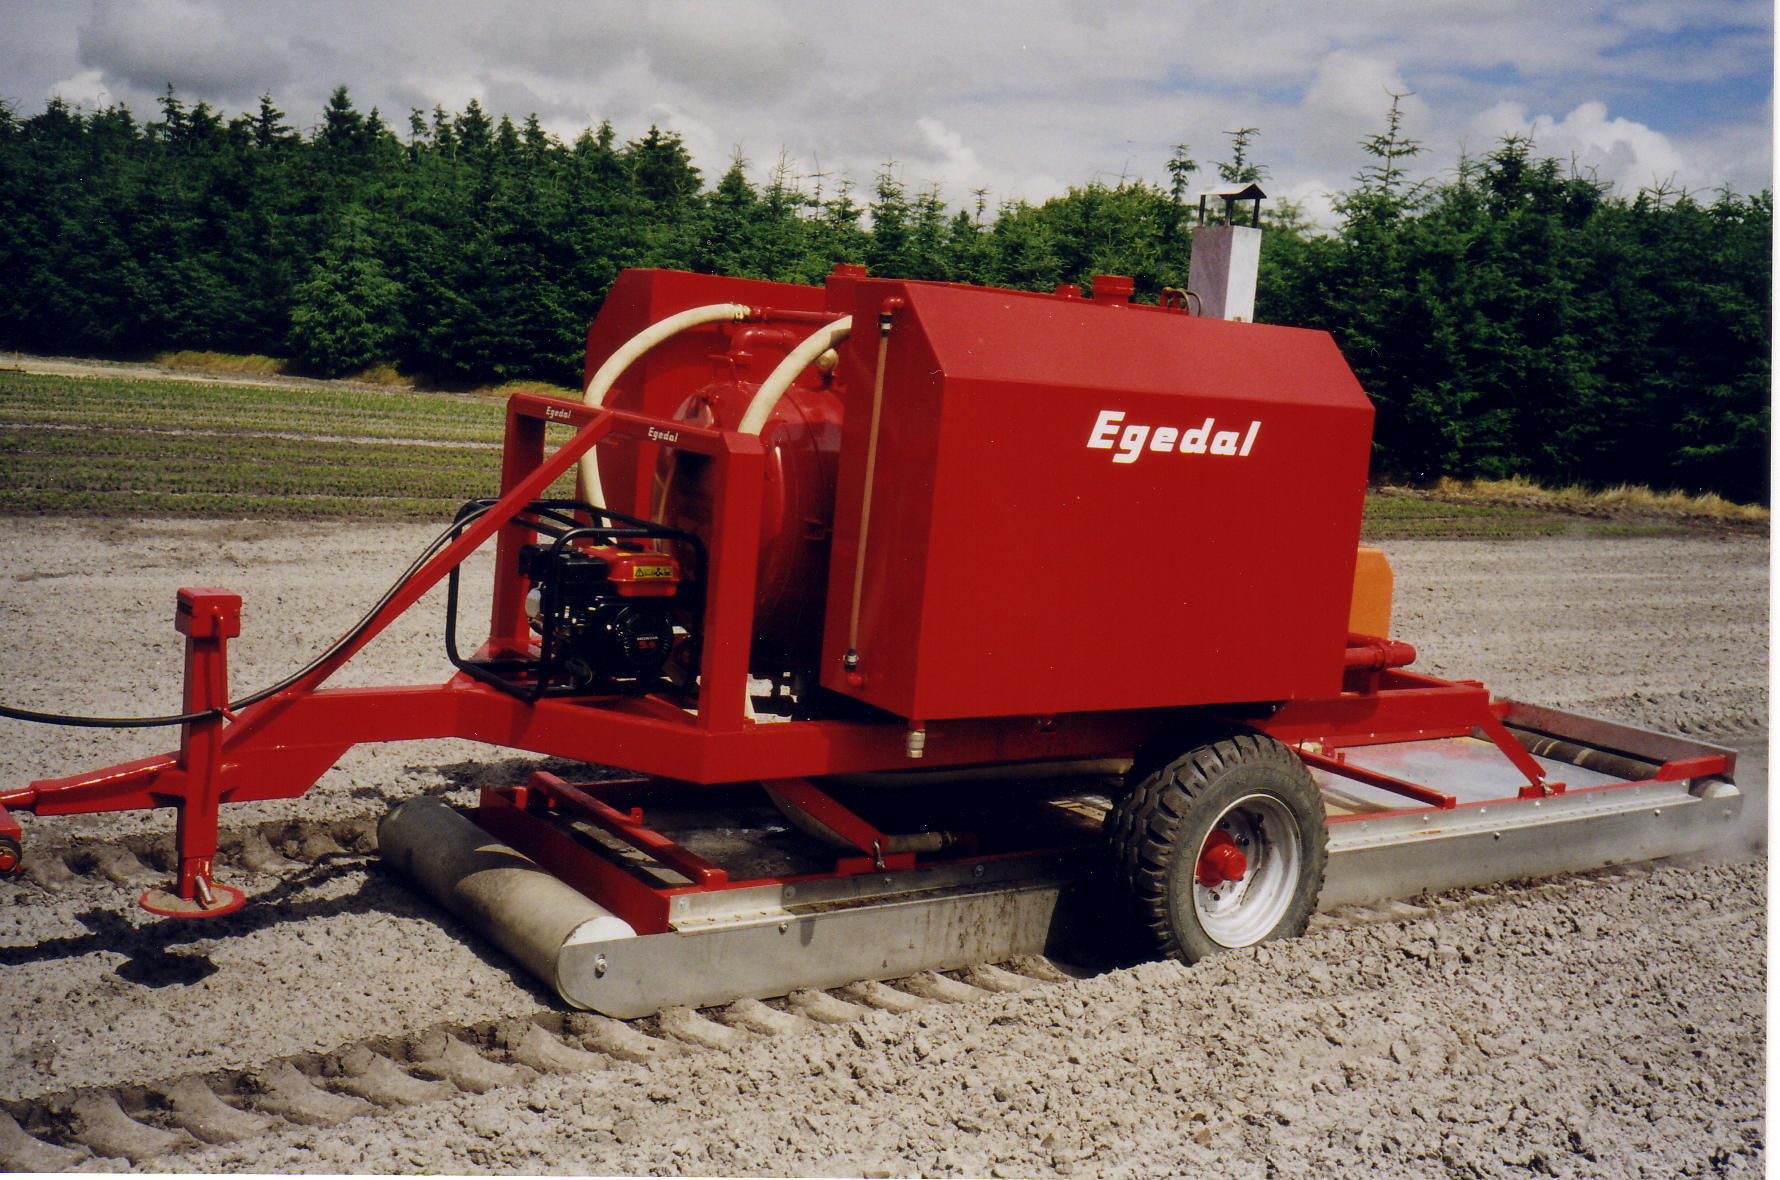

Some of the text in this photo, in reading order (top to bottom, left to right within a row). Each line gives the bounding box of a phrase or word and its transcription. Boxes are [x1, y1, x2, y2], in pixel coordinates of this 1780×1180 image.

[545, 405, 572, 418] Egedal
[647, 426, 679, 442] Egedal
[1086, 410, 1262, 464] Egedal
